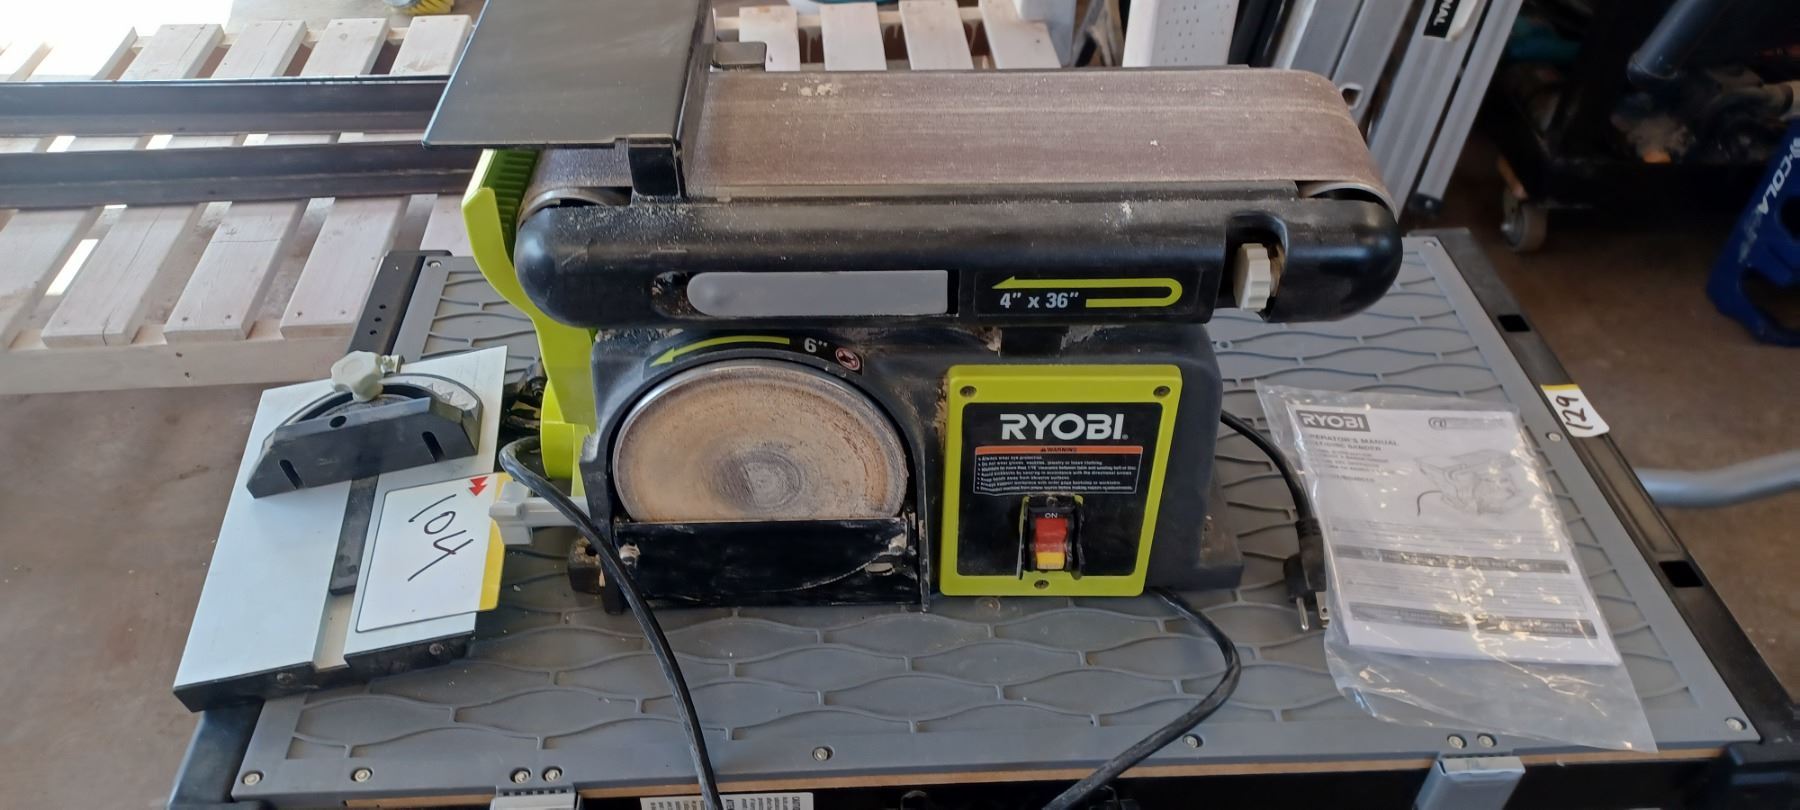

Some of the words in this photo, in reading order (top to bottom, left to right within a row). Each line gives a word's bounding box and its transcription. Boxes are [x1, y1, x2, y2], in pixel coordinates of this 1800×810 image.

[1000, 292, 1021, 309] 4"
[1027, 296, 1040, 308] x
[1045, 292, 1079, 308] 36"
[804, 337, 828, 353] 6"
[1299, 413, 1365, 429] RYOBI
[1556, 395, 1594, 430] 129
[1000, 413, 1125, 440] RYOBI
[408, 493, 474, 582] 104
